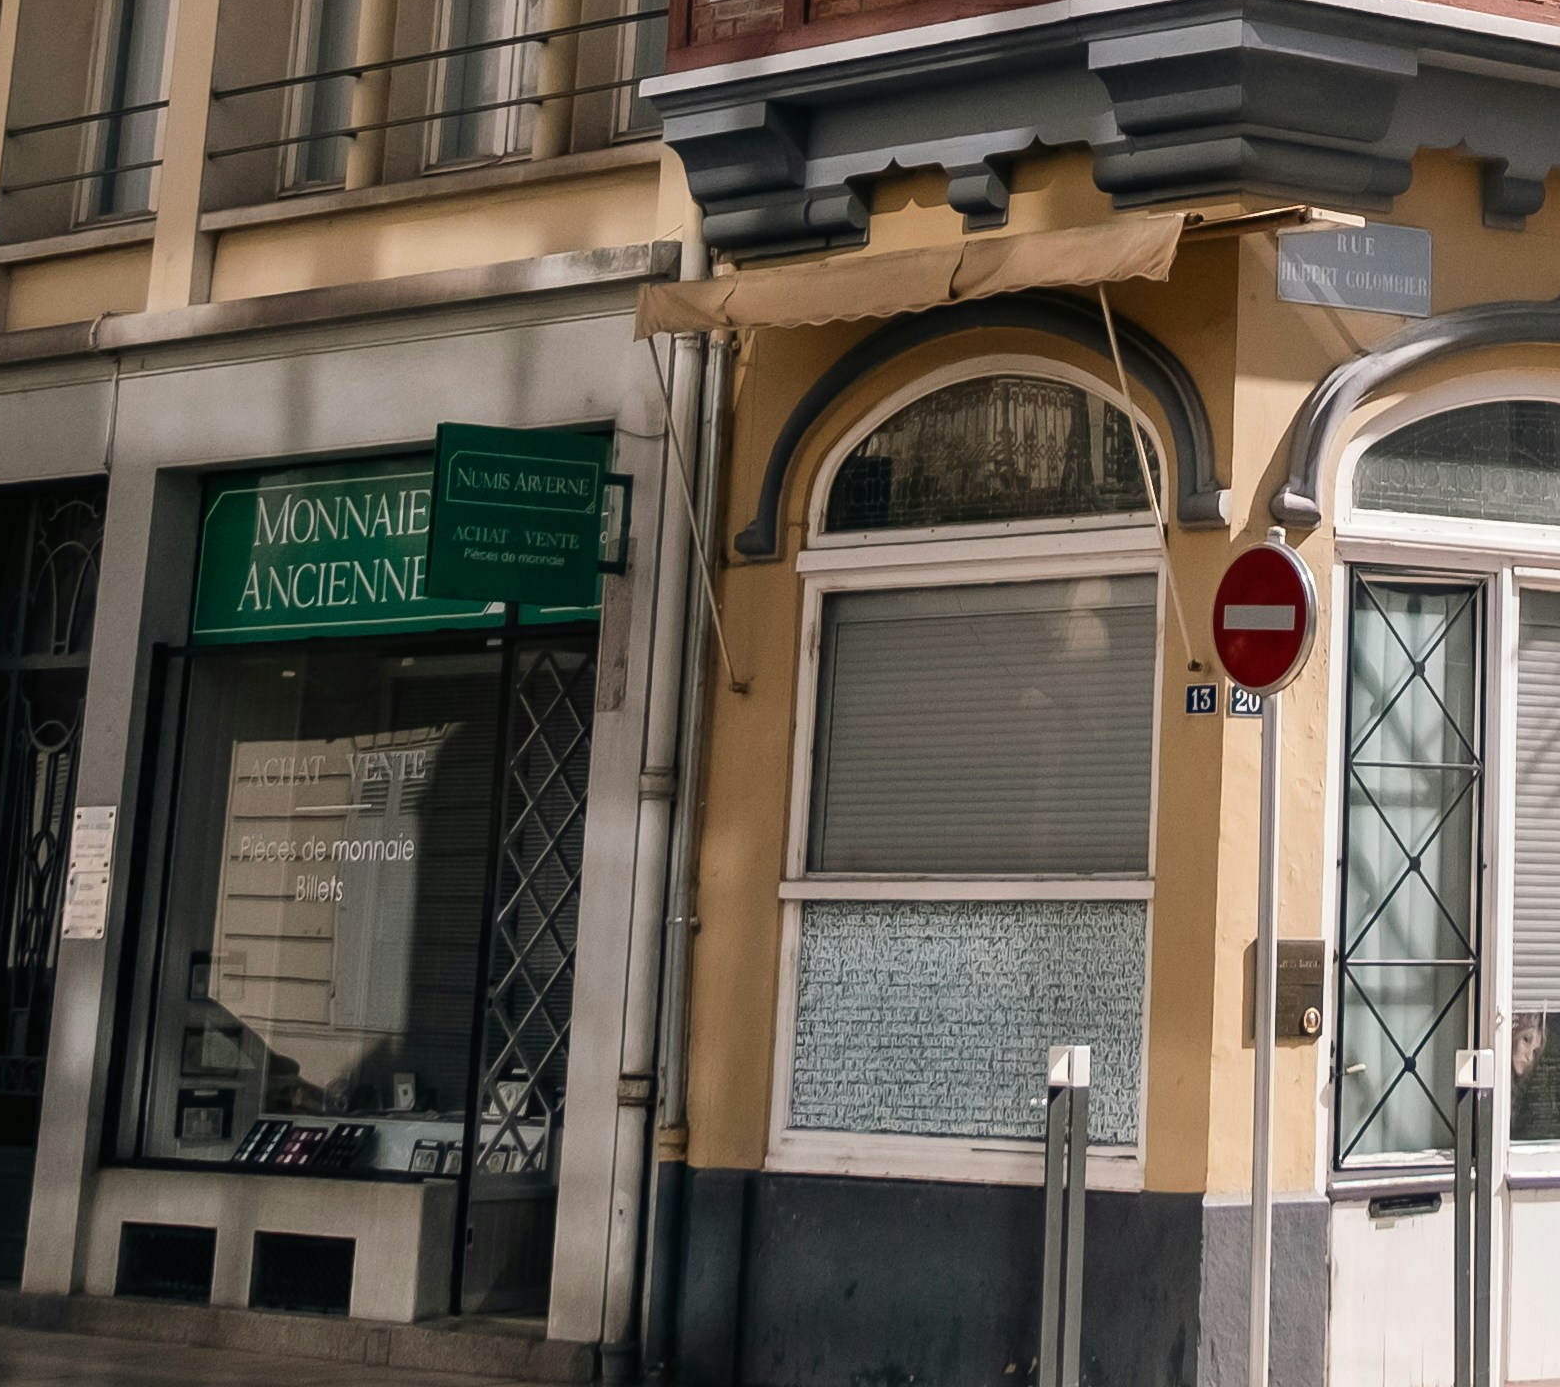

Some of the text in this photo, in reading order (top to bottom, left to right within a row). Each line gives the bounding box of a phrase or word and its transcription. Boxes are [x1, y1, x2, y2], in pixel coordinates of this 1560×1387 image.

[1337, 233, 1376, 256] RUE
[1281, 261, 1428, 297] HUBERT COLOMBIER
[456, 467, 590, 496] NUMIS ARVERNE
[453, 525, 510, 544] ACHAT
[524, 530, 581, 550] VENTE
[501, 549, 515, 563] de
[518, 551, 566, 567] monnaie
[1192, 688, 1211, 711] 13
[1235, 688, 1261, 712] 20
[247, 749, 427, 788] ACHAT VENTE
[239, 833, 416, 863] Pièces de monnaie
[295, 875, 344, 903] Billets
